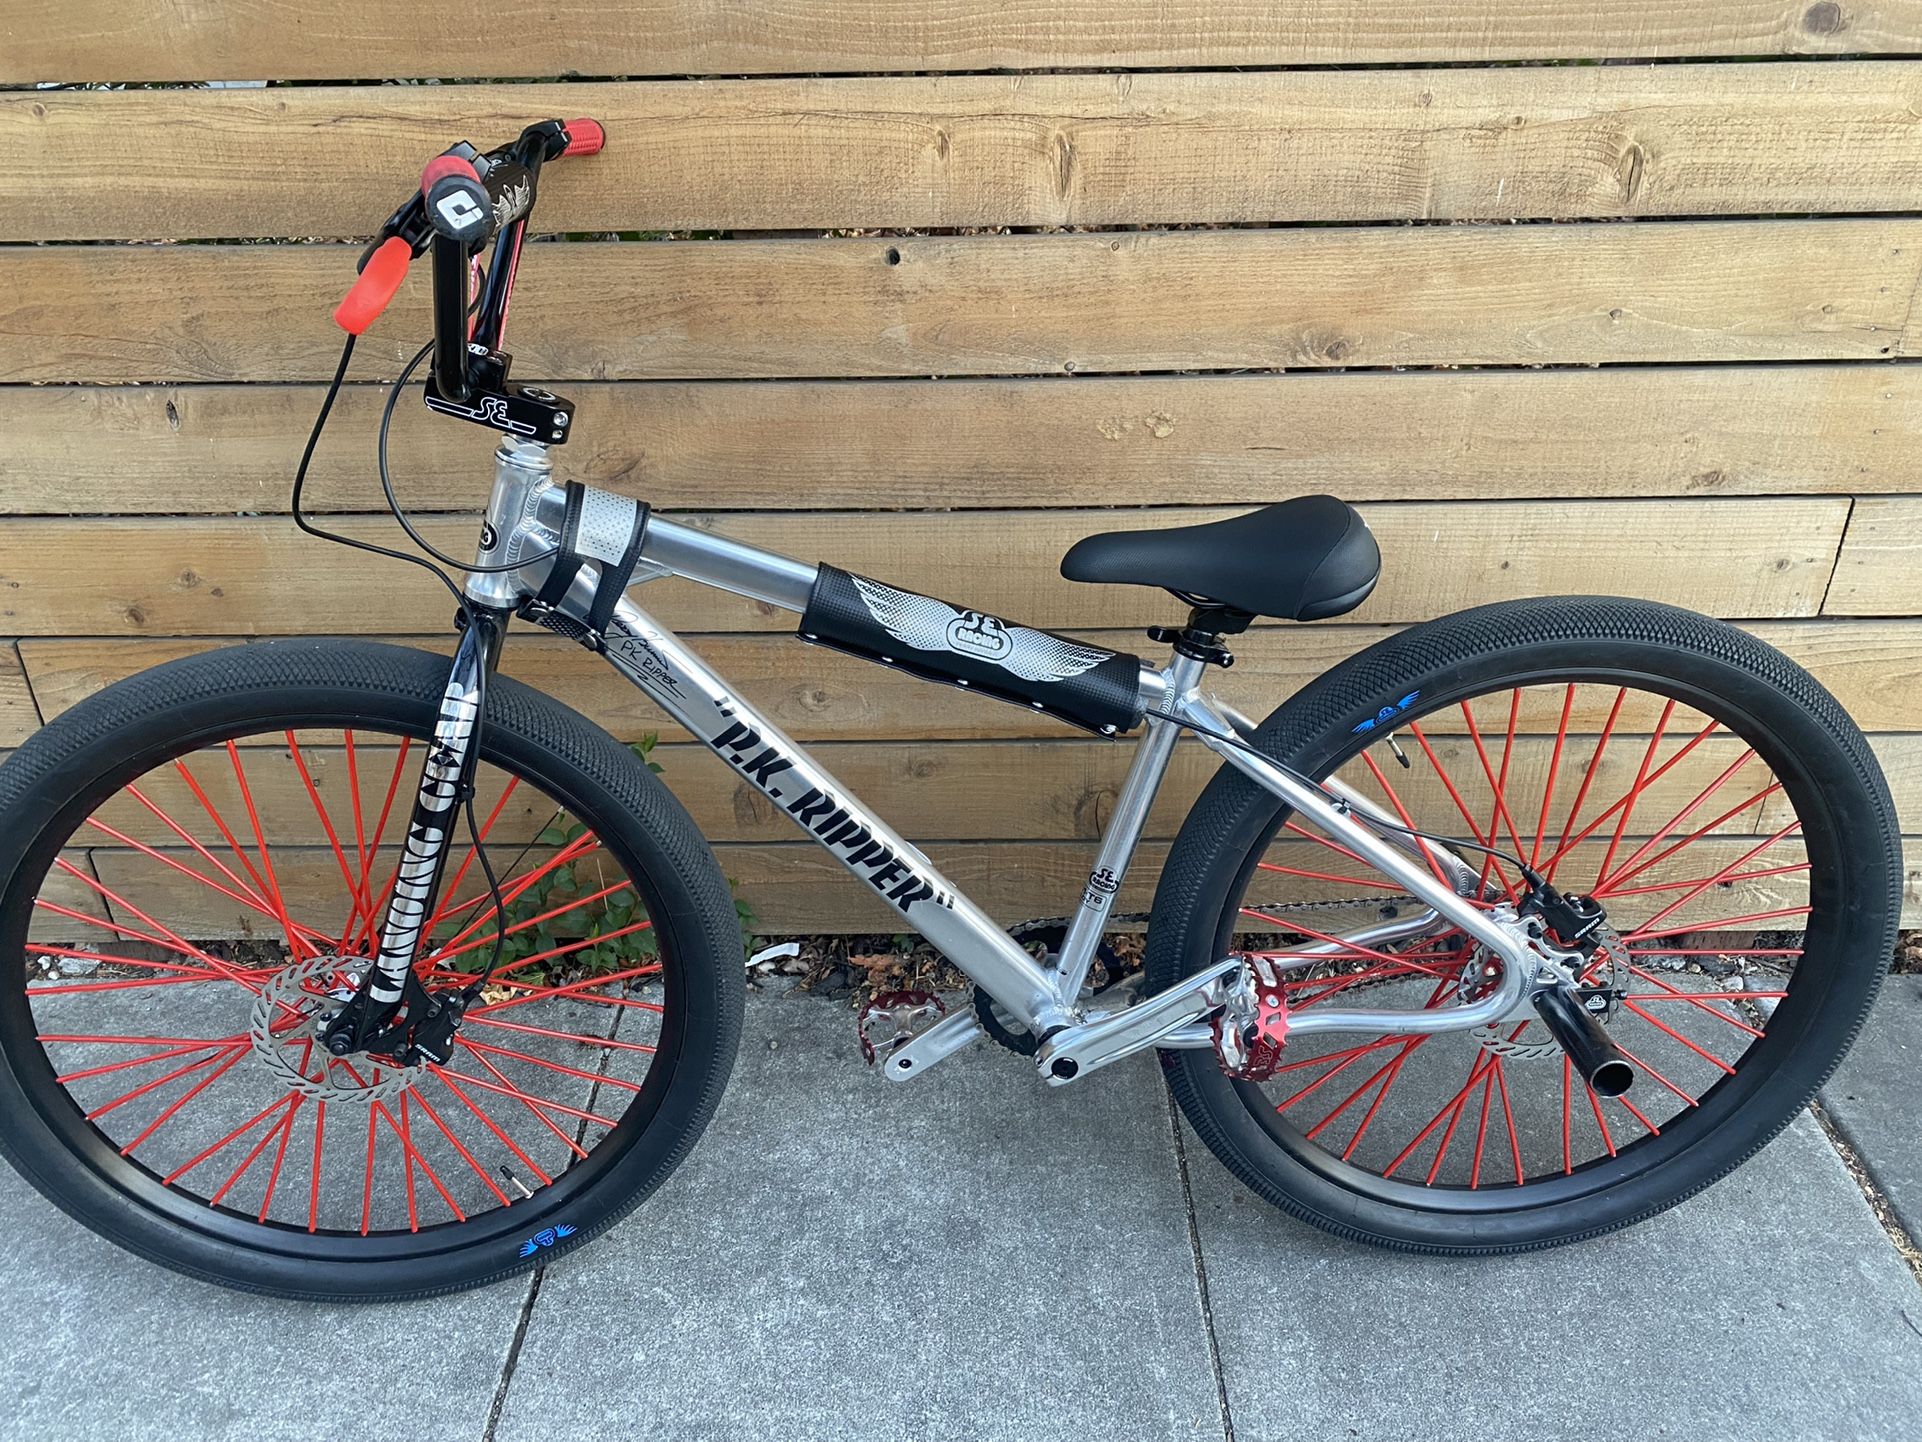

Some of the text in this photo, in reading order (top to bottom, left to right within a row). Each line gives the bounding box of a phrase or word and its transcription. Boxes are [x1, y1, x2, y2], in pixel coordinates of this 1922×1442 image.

[471, 397, 511, 429] SE
[964, 612, 999, 638] SE
[620, 639, 642, 661] PK
[637, 656, 683, 692] RIPPER
[1096, 868, 1114, 883] SE
[1574, 917, 1600, 939] SRAM
[415, 1043, 440, 1062] SRAM
